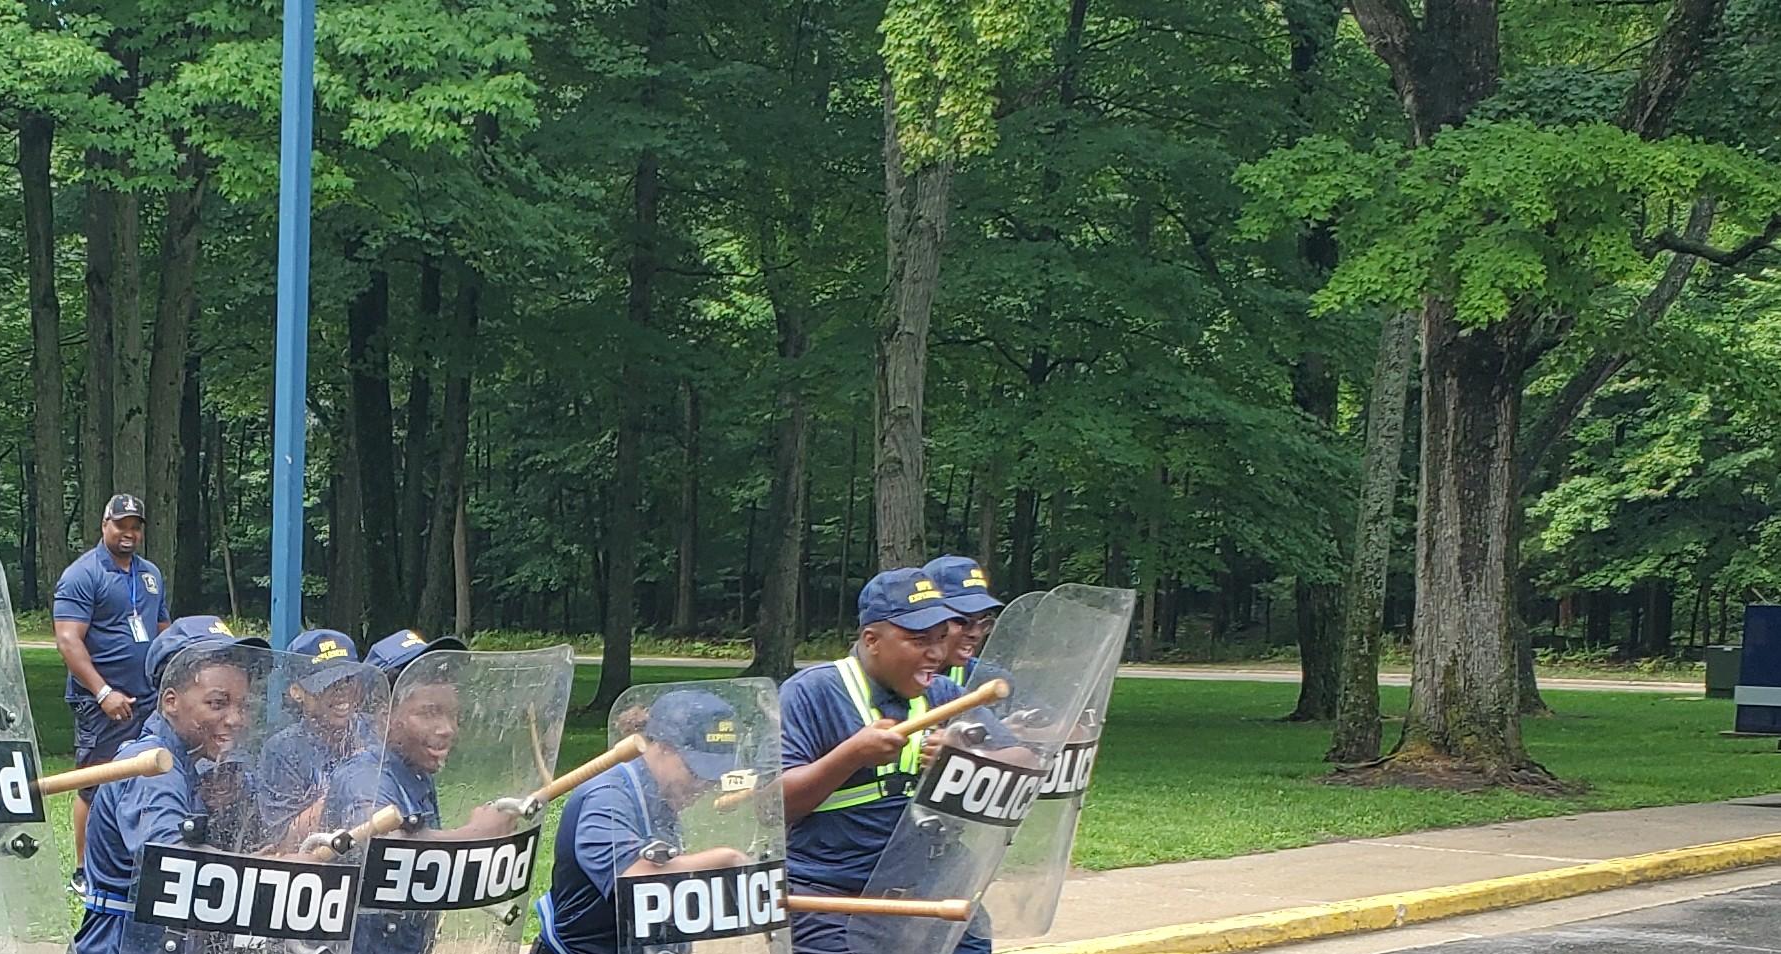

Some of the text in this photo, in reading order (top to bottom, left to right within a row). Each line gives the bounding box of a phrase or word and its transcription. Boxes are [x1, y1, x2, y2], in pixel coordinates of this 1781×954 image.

[1038, 748, 1097, 793] OLIC
[152, 856, 352, 934] POLICE
[374, 835, 535, 903] POLICE
[632, 867, 787, 939] POLICE
